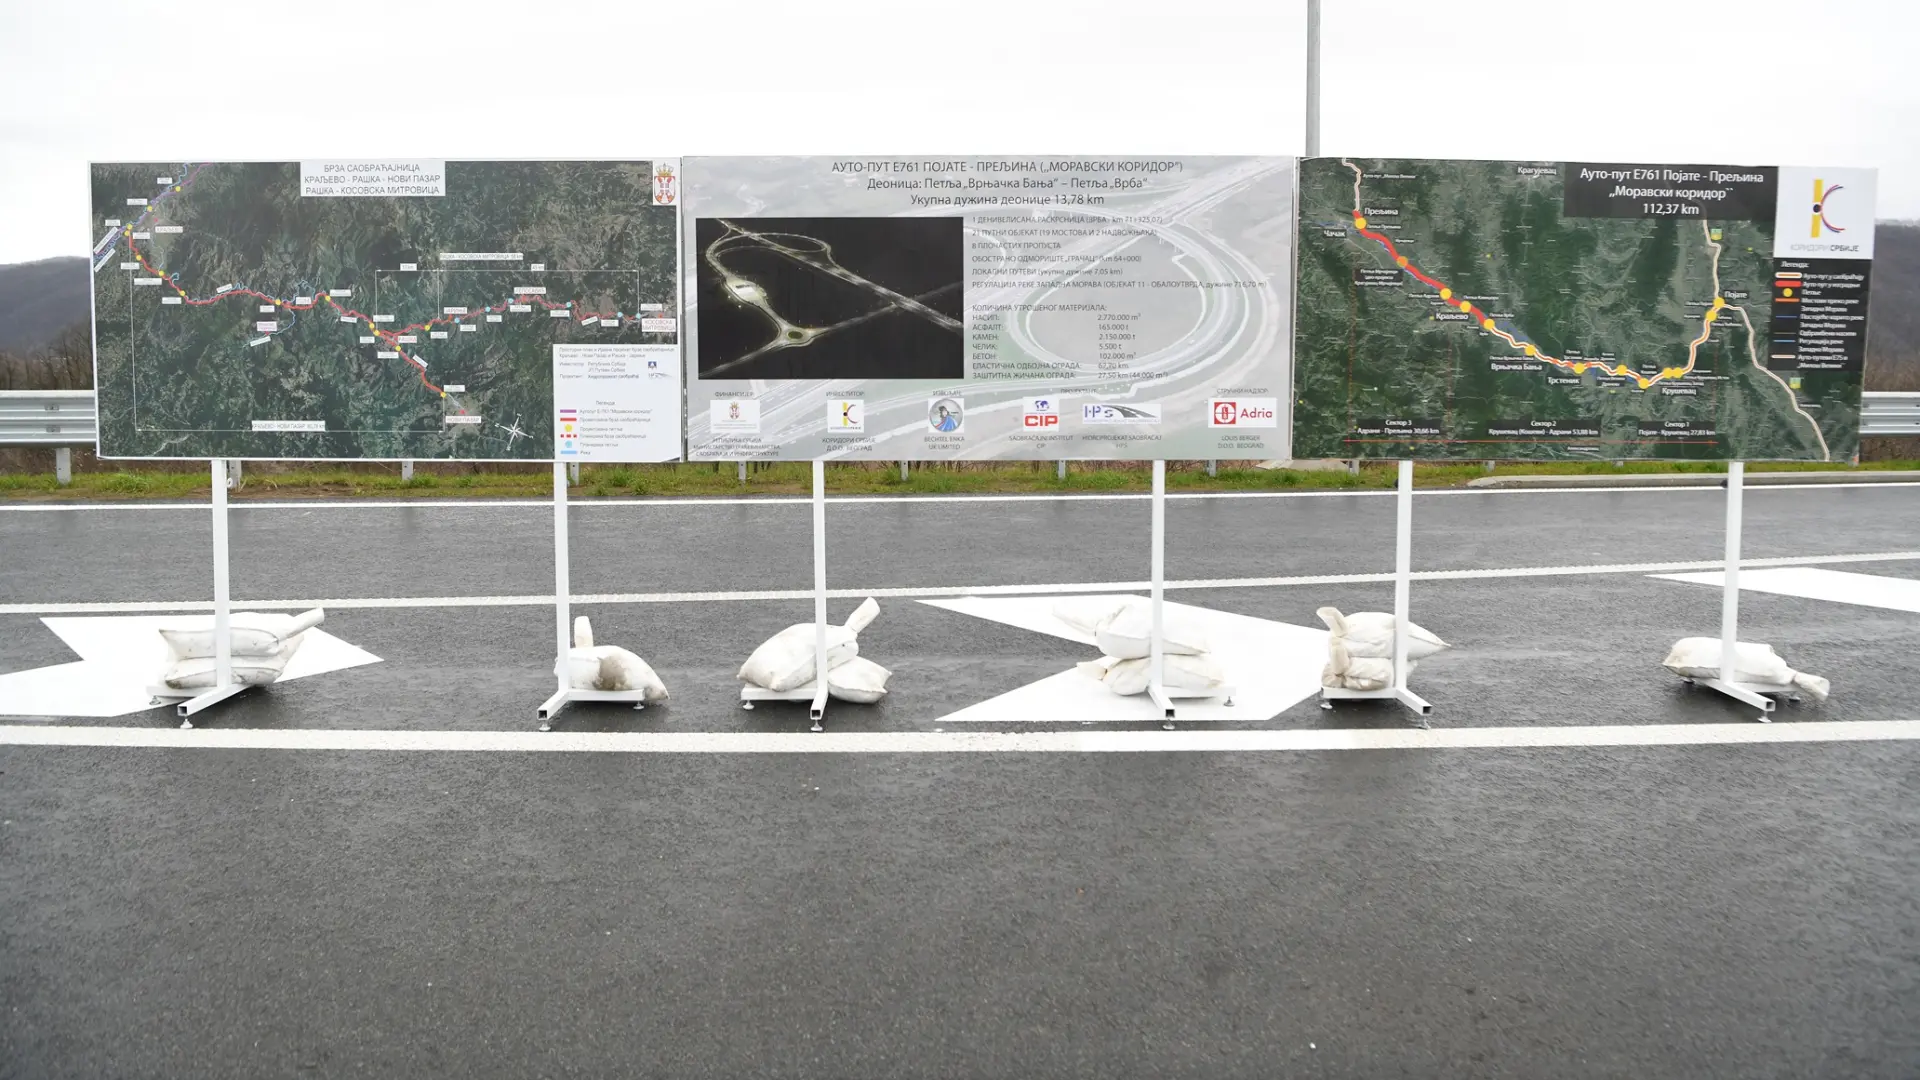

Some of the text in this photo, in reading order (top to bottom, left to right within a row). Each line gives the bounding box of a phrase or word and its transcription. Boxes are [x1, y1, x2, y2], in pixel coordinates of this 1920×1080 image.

[324, 164, 420, 173] БРЗА САОБРАЋАЈНИЦА
[832, 162, 890, 172] АУТО-ПУТ
[923, 162, 967, 172] ПОЈАТЕ
[976, 162, 1036, 172] ПРЕЉИНА
[1518, 166, 1556, 175] Крагујевац
[304, 176, 346, 184] КРАЉЕВО
[388, 175, 411, 183] НОВИ
[413, 174, 440, 183] ПАЗАР
[1580, 168, 1631, 181] Ауто-пут
[1663, 170, 1700, 183] Појате
[1709, 171, 1764, 184] Прељина
[867, 178, 922, 190] Деоница:
[924, 178, 961, 188] Петља
[1071, 178, 1108, 188] Петља
[340, 186, 385, 194] КОСОВСКА
[388, 186, 440, 194] МИТРОВИЦА
[911, 194, 1104, 207] Укупна дужина деонице 13,78 km
[1364, 208, 1398, 216] Прељина
[1643, 204, 1699, 215] 112,37 km
[1724, 291, 1748, 299] Појате
[1240, 407, 1273, 418] Adria
[1025, 415, 1058, 427] CIP
